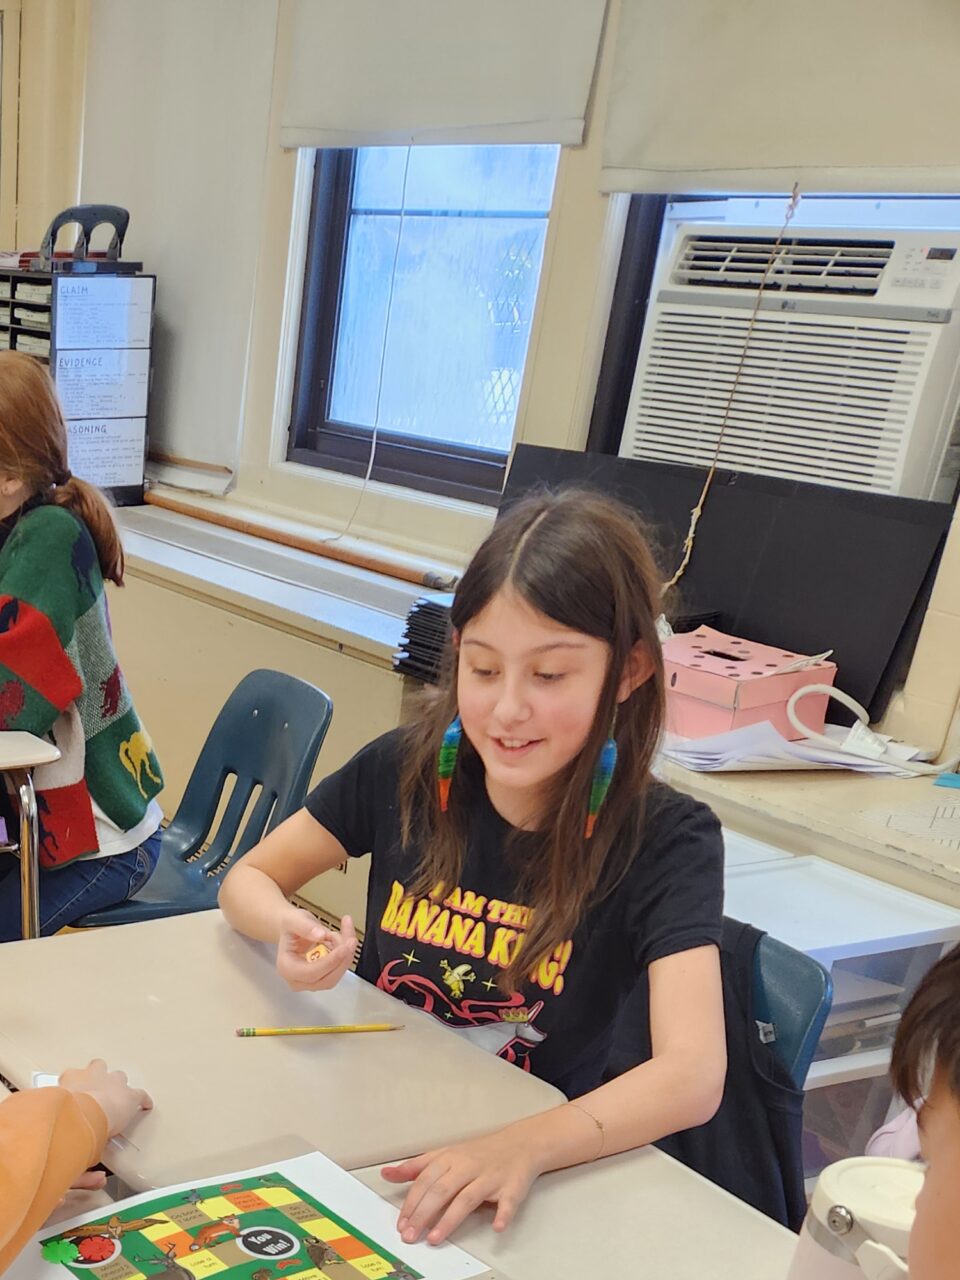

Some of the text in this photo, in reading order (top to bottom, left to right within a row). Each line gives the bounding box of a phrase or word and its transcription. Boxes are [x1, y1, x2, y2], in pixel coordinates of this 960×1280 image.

[60, 286, 88, 295] CLAIM
[60, 357, 103, 367] EVIDENCE
[443, 886, 488, 918] AM
[381, 879, 486, 959] BANANA
[247, 1233, 273, 1245] You
[263, 1239, 290, 1255] Win!
